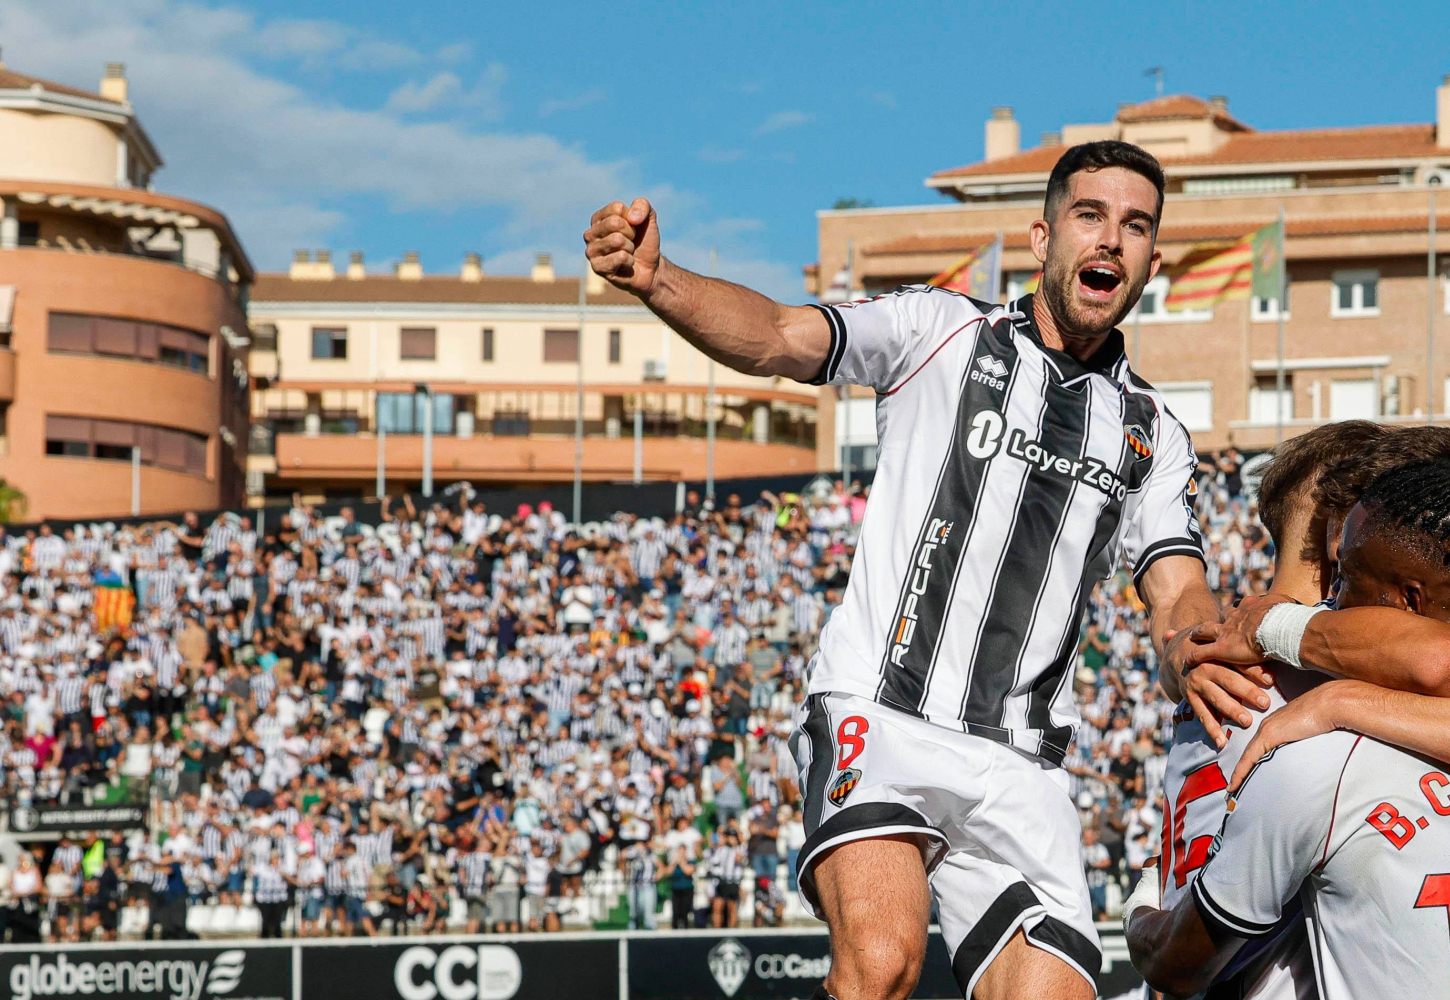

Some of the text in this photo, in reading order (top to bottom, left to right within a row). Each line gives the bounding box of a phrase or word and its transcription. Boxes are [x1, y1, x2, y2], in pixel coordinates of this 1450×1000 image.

[970, 369, 1006, 392] errea
[890, 517, 947, 669] REPCAR
[836, 715, 870, 770] 8
[1364, 801, 1430, 851] B.
